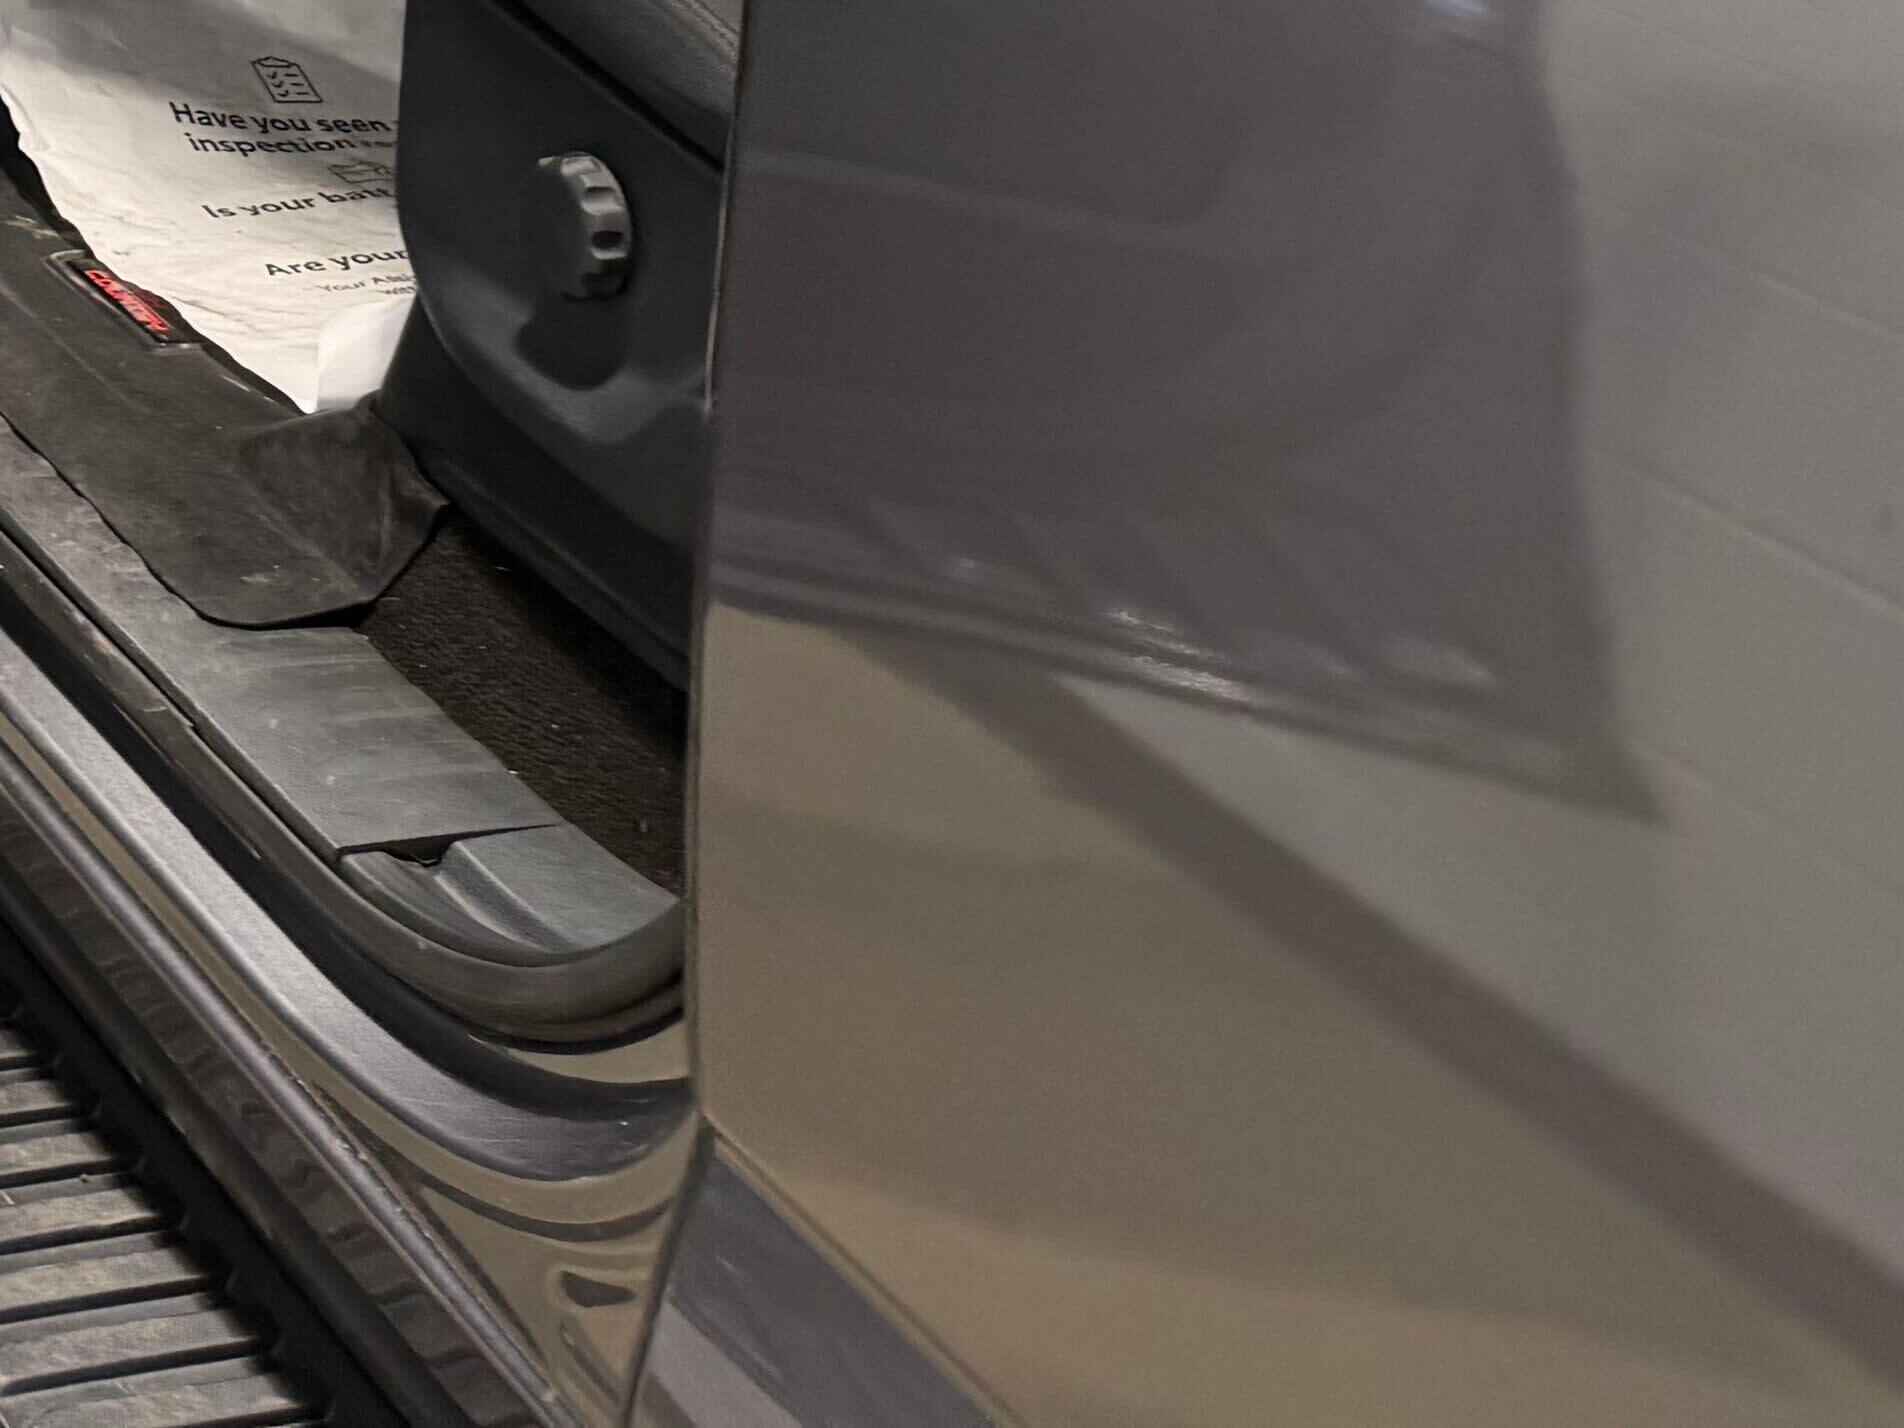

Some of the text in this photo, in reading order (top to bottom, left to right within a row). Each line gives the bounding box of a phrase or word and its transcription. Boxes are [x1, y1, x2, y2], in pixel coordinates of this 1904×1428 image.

[169, 101, 392, 133] Have you seen
[185, 132, 352, 157] inspection
[202, 204, 236, 218] Is
[242, 197, 316, 217] your
[266, 249, 408, 276] Are your
